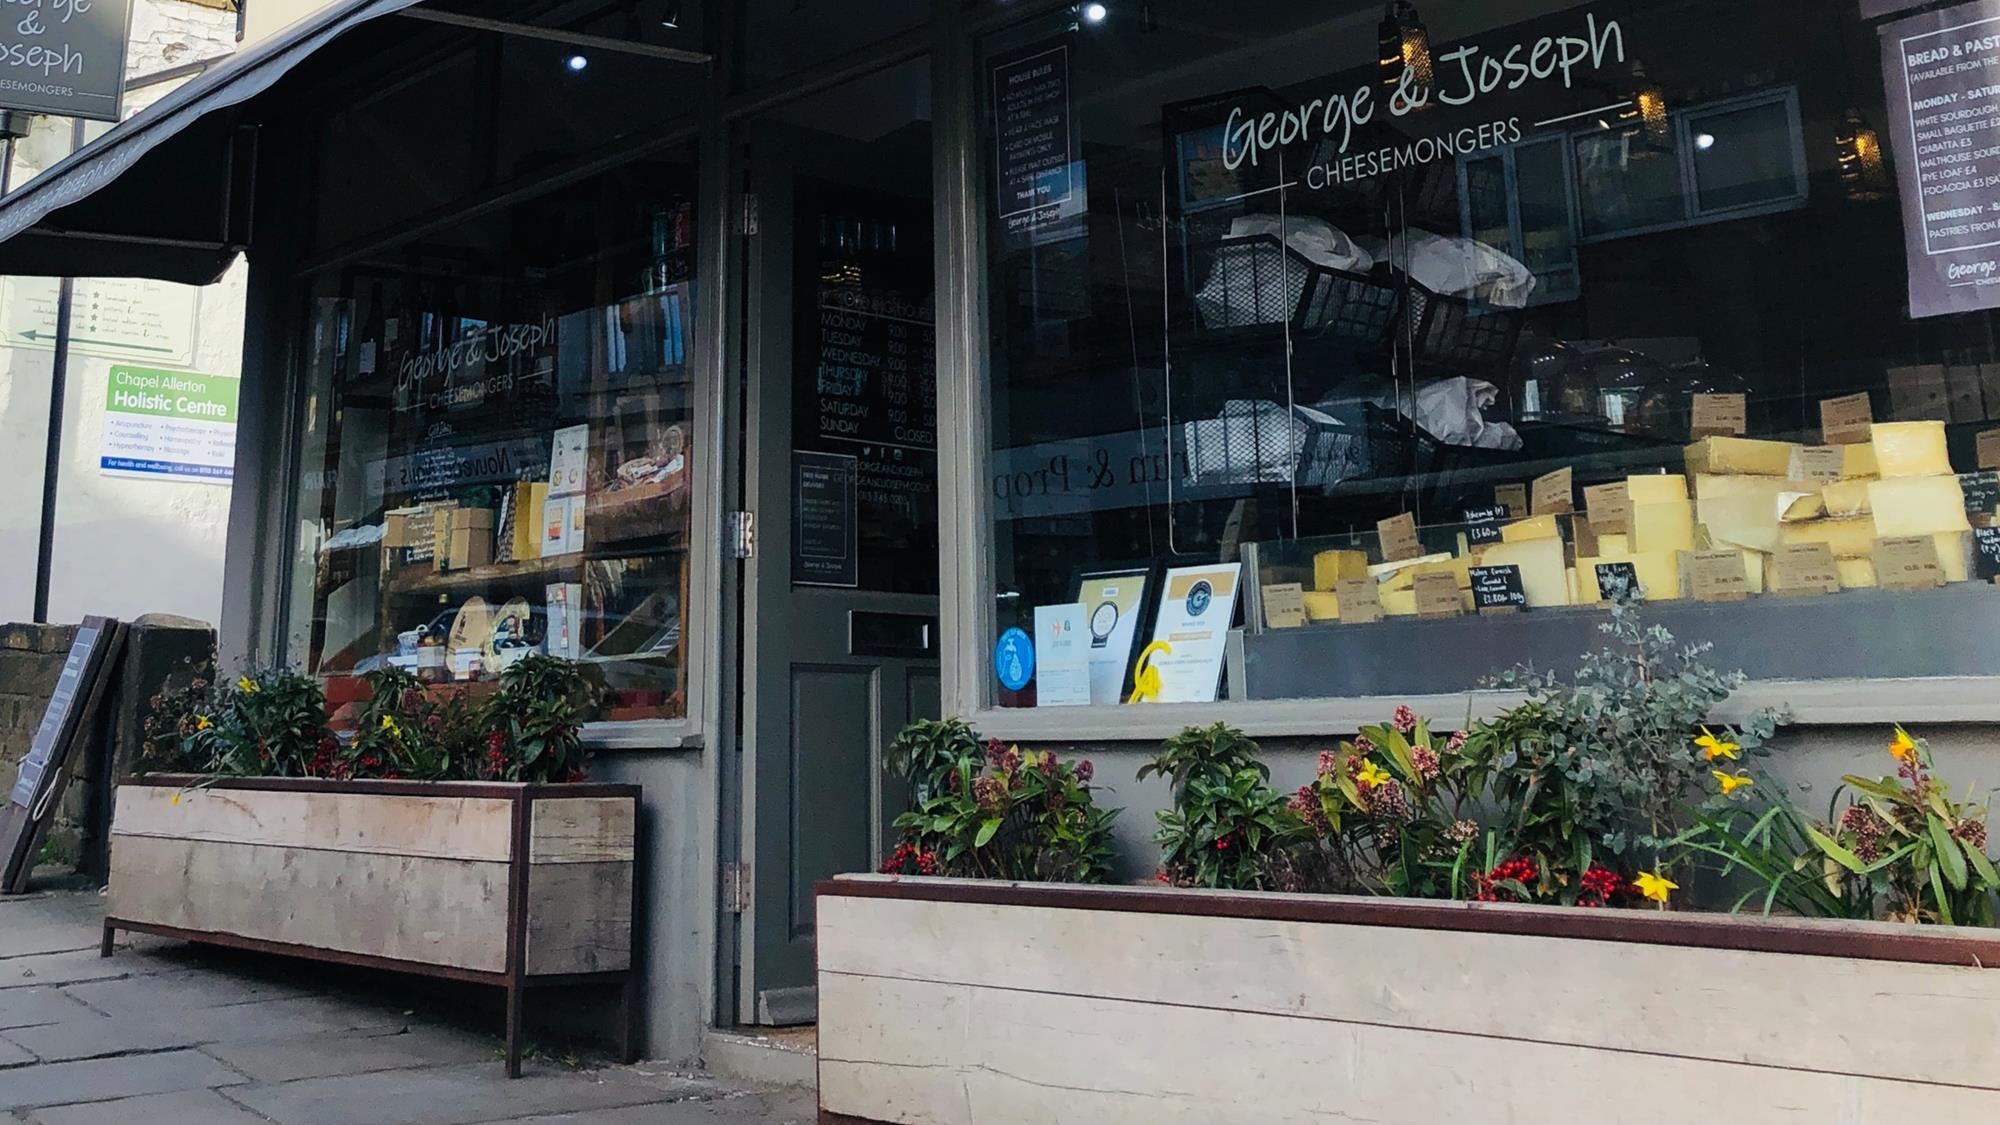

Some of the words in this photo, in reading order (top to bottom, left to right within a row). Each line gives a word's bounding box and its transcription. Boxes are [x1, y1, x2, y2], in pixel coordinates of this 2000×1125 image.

[17, 10, 46, 35] &
[1907, 47, 1949, 67] BREAD
[1952, 45, 1963, 57] &
[1955, 60, 1981, 72] FROM
[1982, 55, 1999, 66] THE
[1221, 84, 1376, 170] George
[1389, 65, 1429, 117] &
[1438, 12, 1625, 105] Joseph
[1913, 93, 1958, 111] MONDAY
[1915, 114, 1939, 127] WHITE
[1940, 104, 1998, 122] SOURDOUGH
[1917, 130, 1943, 142] SMALL
[1944, 120, 1988, 136] BAGUETTE
[1306, 117, 1522, 190] CHEESEMONGERS
[1918, 140, 1959, 155] CIABATTA
[1960, 137, 1972, 147] £3
[1920, 152, 1972, 169] MALTHOUSE
[1921, 172, 1938, 183] RYE
[1939, 167, 1962, 180] LOAF
[1016, 188, 1035, 200] THANK
[1036, 185, 1051, 195] YOU
[1923, 181, 1971, 196] FOCACCIA
[1927, 205, 1984, 222] WEDNESDAY
[1929, 224, 1969, 239] PASTRIES
[1971, 220, 1996, 233] FROM
[1948, 260, 1997, 279] George
[820, 313, 867, 331] MONDAY
[821, 328, 863, 346] TUESDAY
[398, 343, 462, 391] George
[464, 334, 484, 367] &
[485, 311, 555, 363] Joseph
[821, 345, 881, 367] WEDNESDAY
[116, 371, 159, 389] Chapel
[161, 376, 207, 393] Allerton
[429, 372, 514, 409] CHEESEMONGERS
[114, 390, 172, 411] Holistic
[176, 396, 227, 417] Centre
[820, 398, 870, 417] SATURDAY
[819, 415, 860, 433] SUNDAY
[894, 425, 933, 444] CLOSED
[108, 458, 117, 467] For
